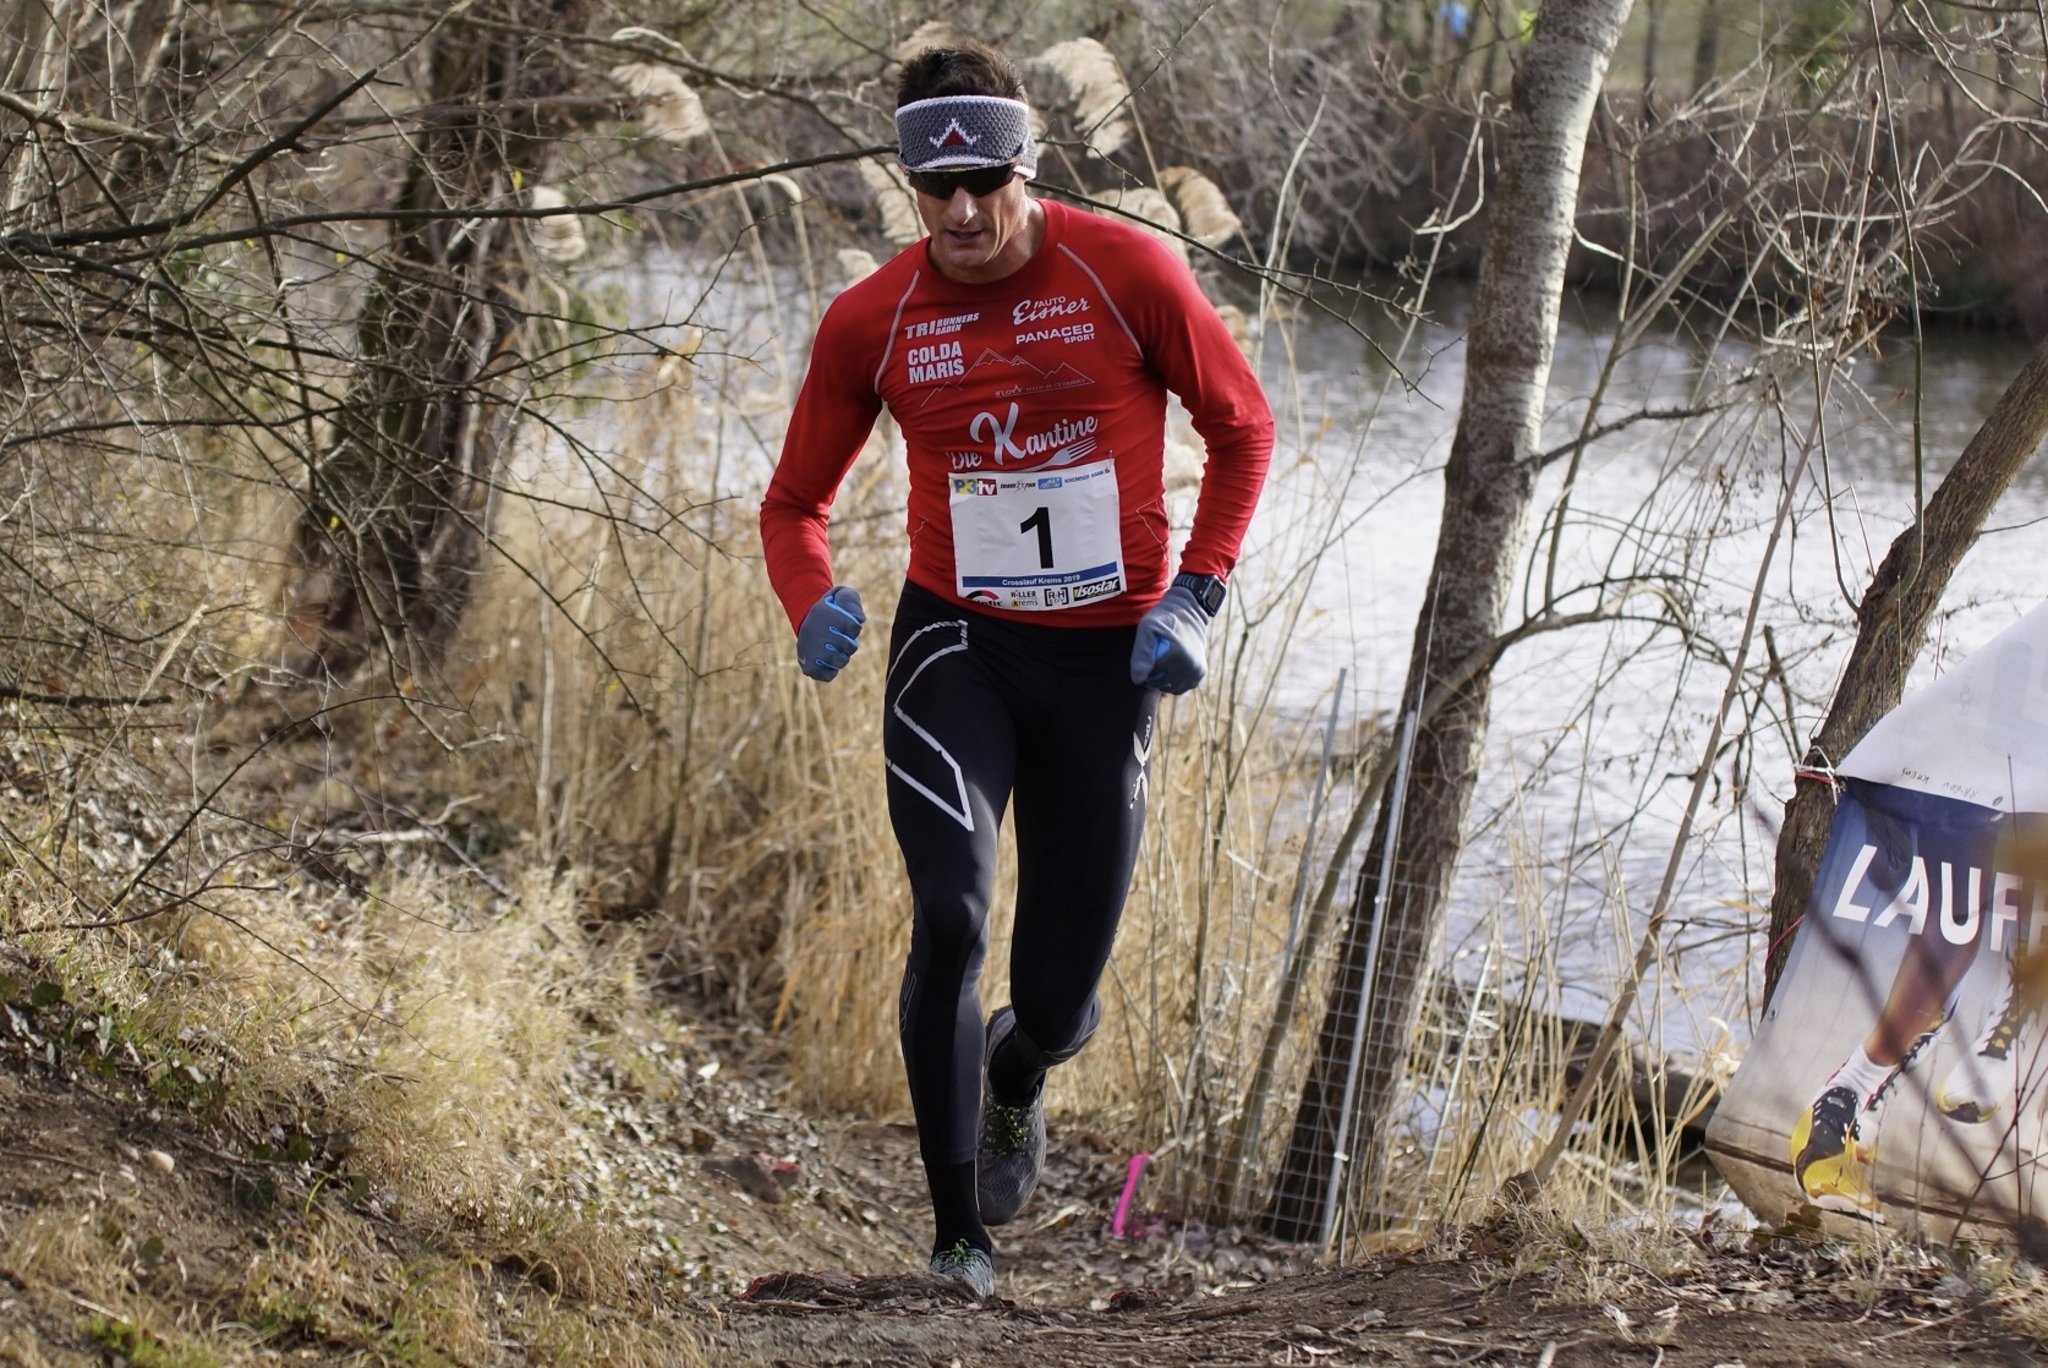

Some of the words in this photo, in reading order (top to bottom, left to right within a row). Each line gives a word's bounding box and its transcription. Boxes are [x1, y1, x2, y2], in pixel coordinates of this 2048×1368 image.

[1038, 295, 1066, 308] AUTO
[936, 312, 980, 328] RUNNERS
[905, 321, 936, 340] TRI
[1015, 323, 1095, 345] PANACEO
[1063, 332, 1095, 344] SPORT
[908, 340, 963, 366] COLDA
[908, 358, 965, 384] MARIS
[969, 402, 1098, 466] Kantine
[1020, 506, 1054, 569] 1
[1002, 578, 1037, 586] Crosslauf
[1038, 577, 1061, 585] Krems
[1063, 574, 1080, 583] 2019
